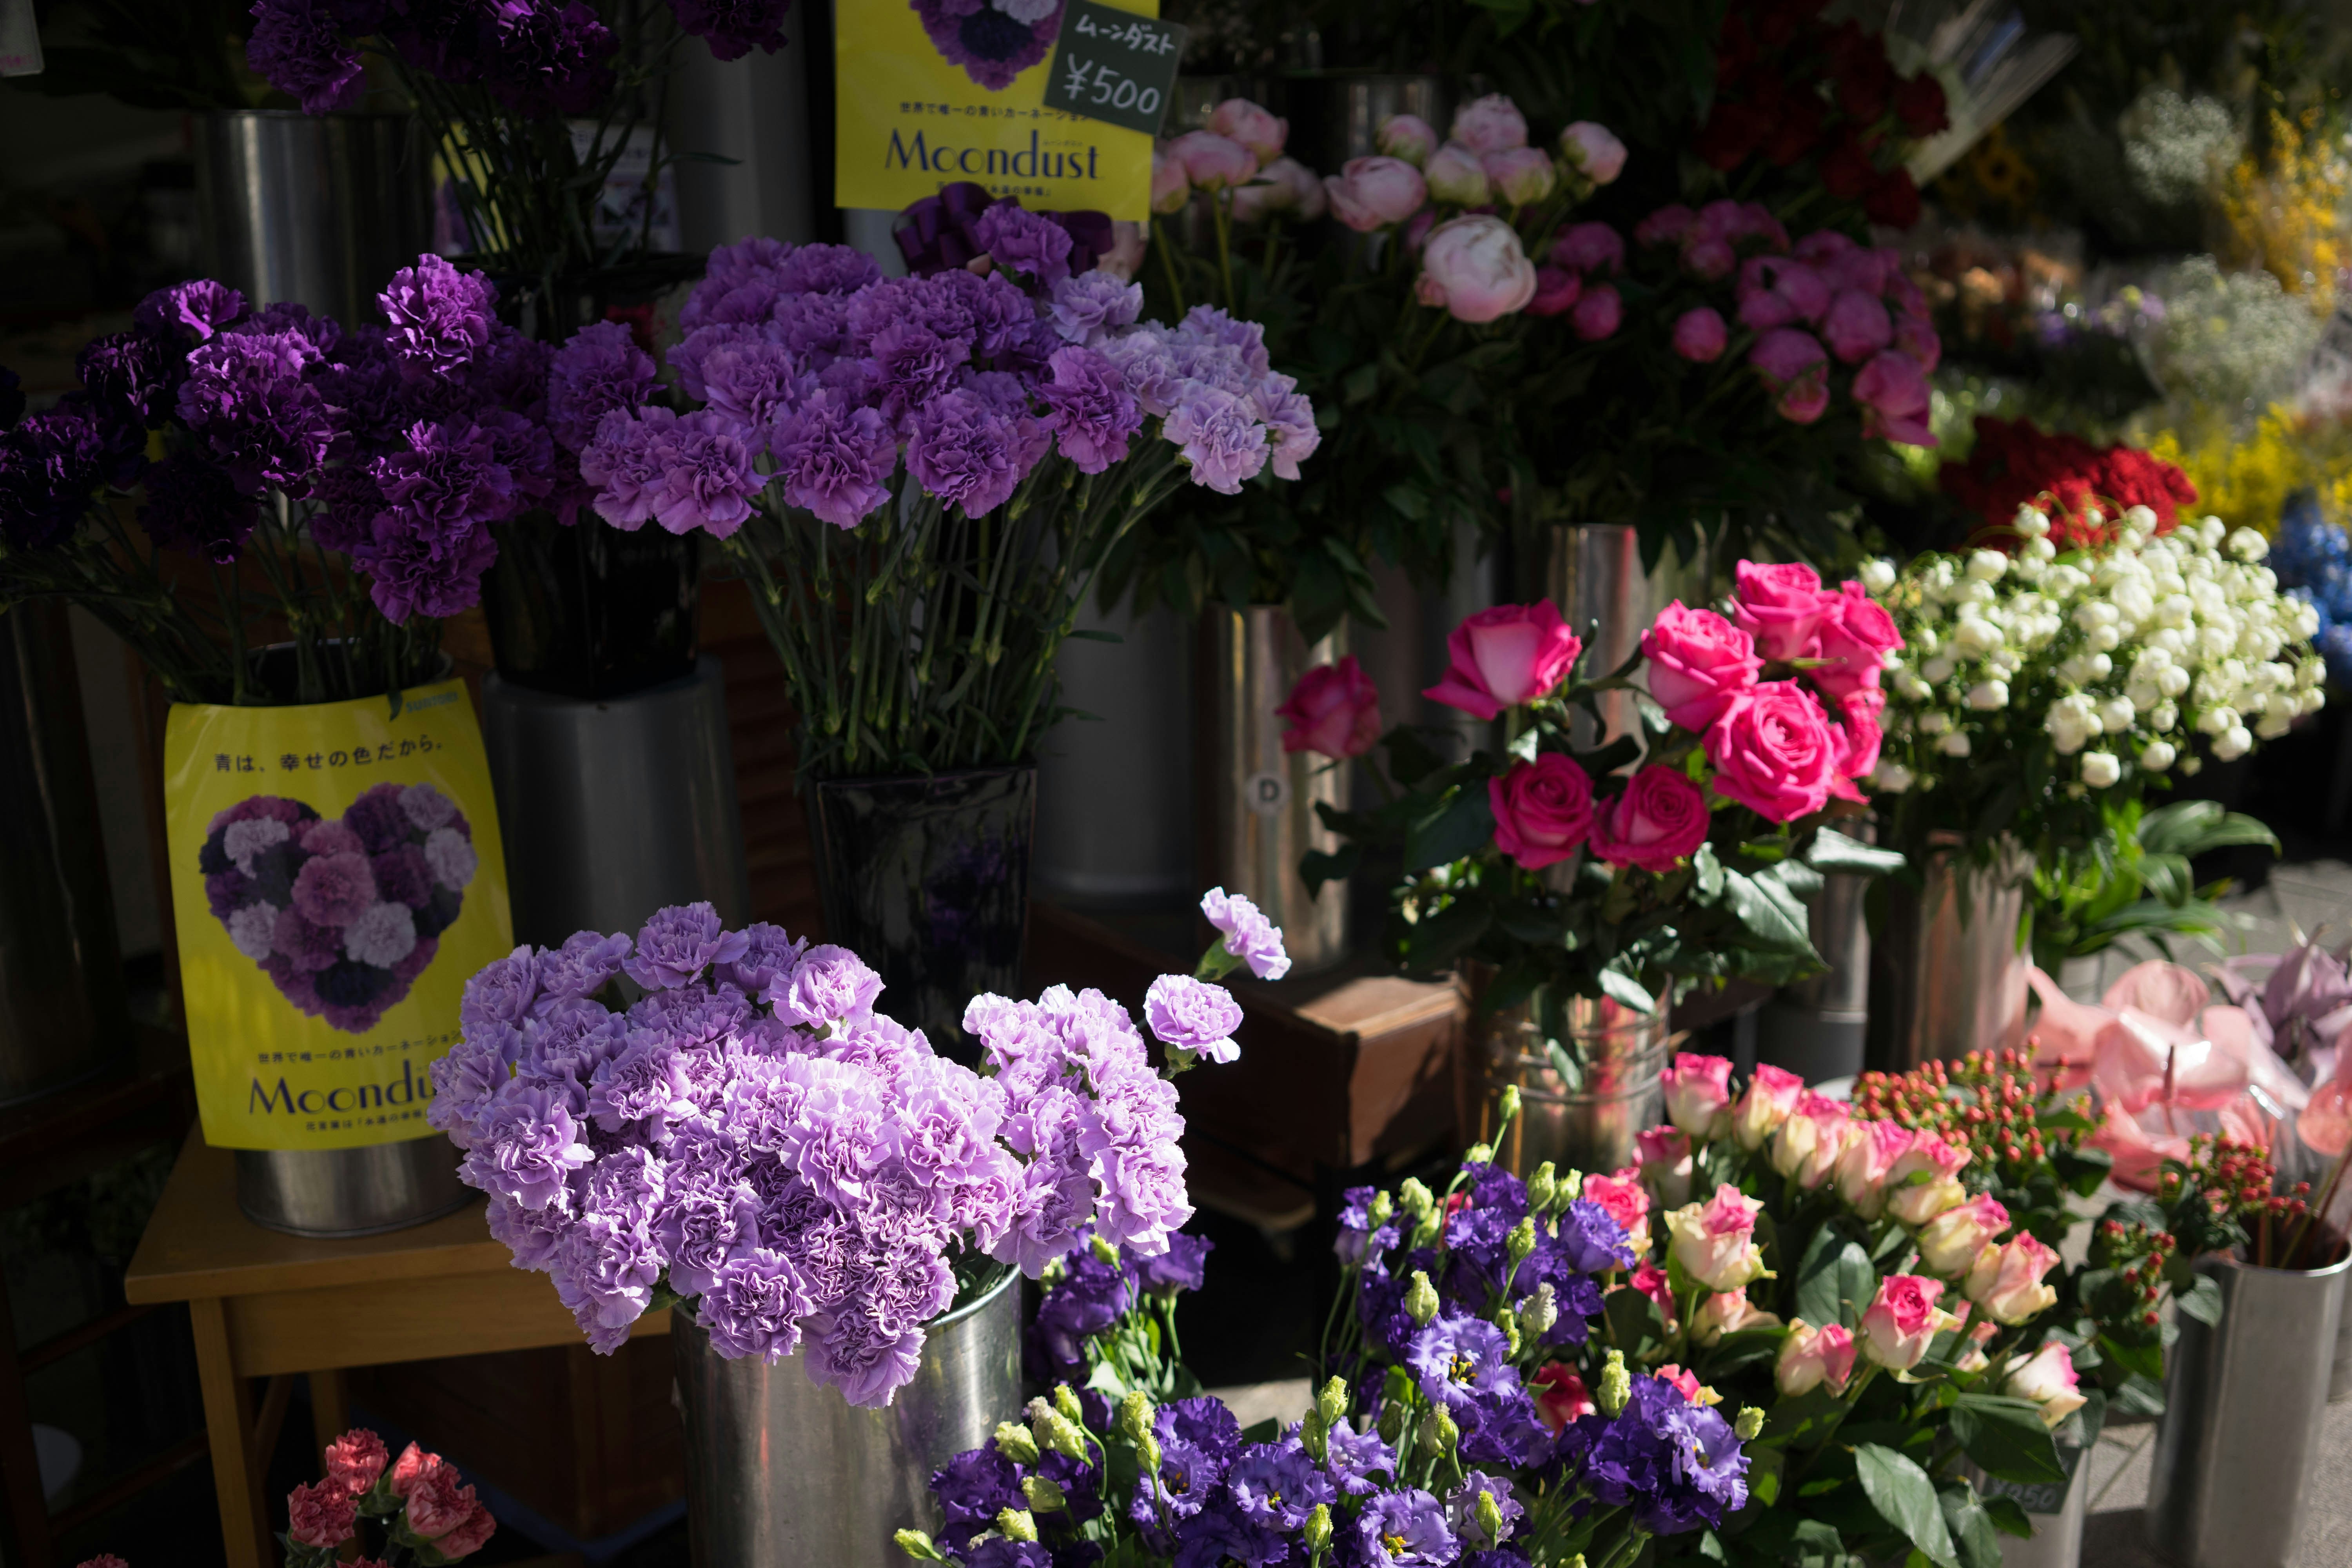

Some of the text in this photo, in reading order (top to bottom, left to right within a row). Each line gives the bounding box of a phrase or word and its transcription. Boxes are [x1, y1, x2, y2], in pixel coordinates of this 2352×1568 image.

[1074, 14, 1175, 56] ムーンダスト
[1063, 53, 1161, 115] ¥500
[885, 128, 1101, 180] Moondust
[249, 1059, 437, 1115] Moondu
